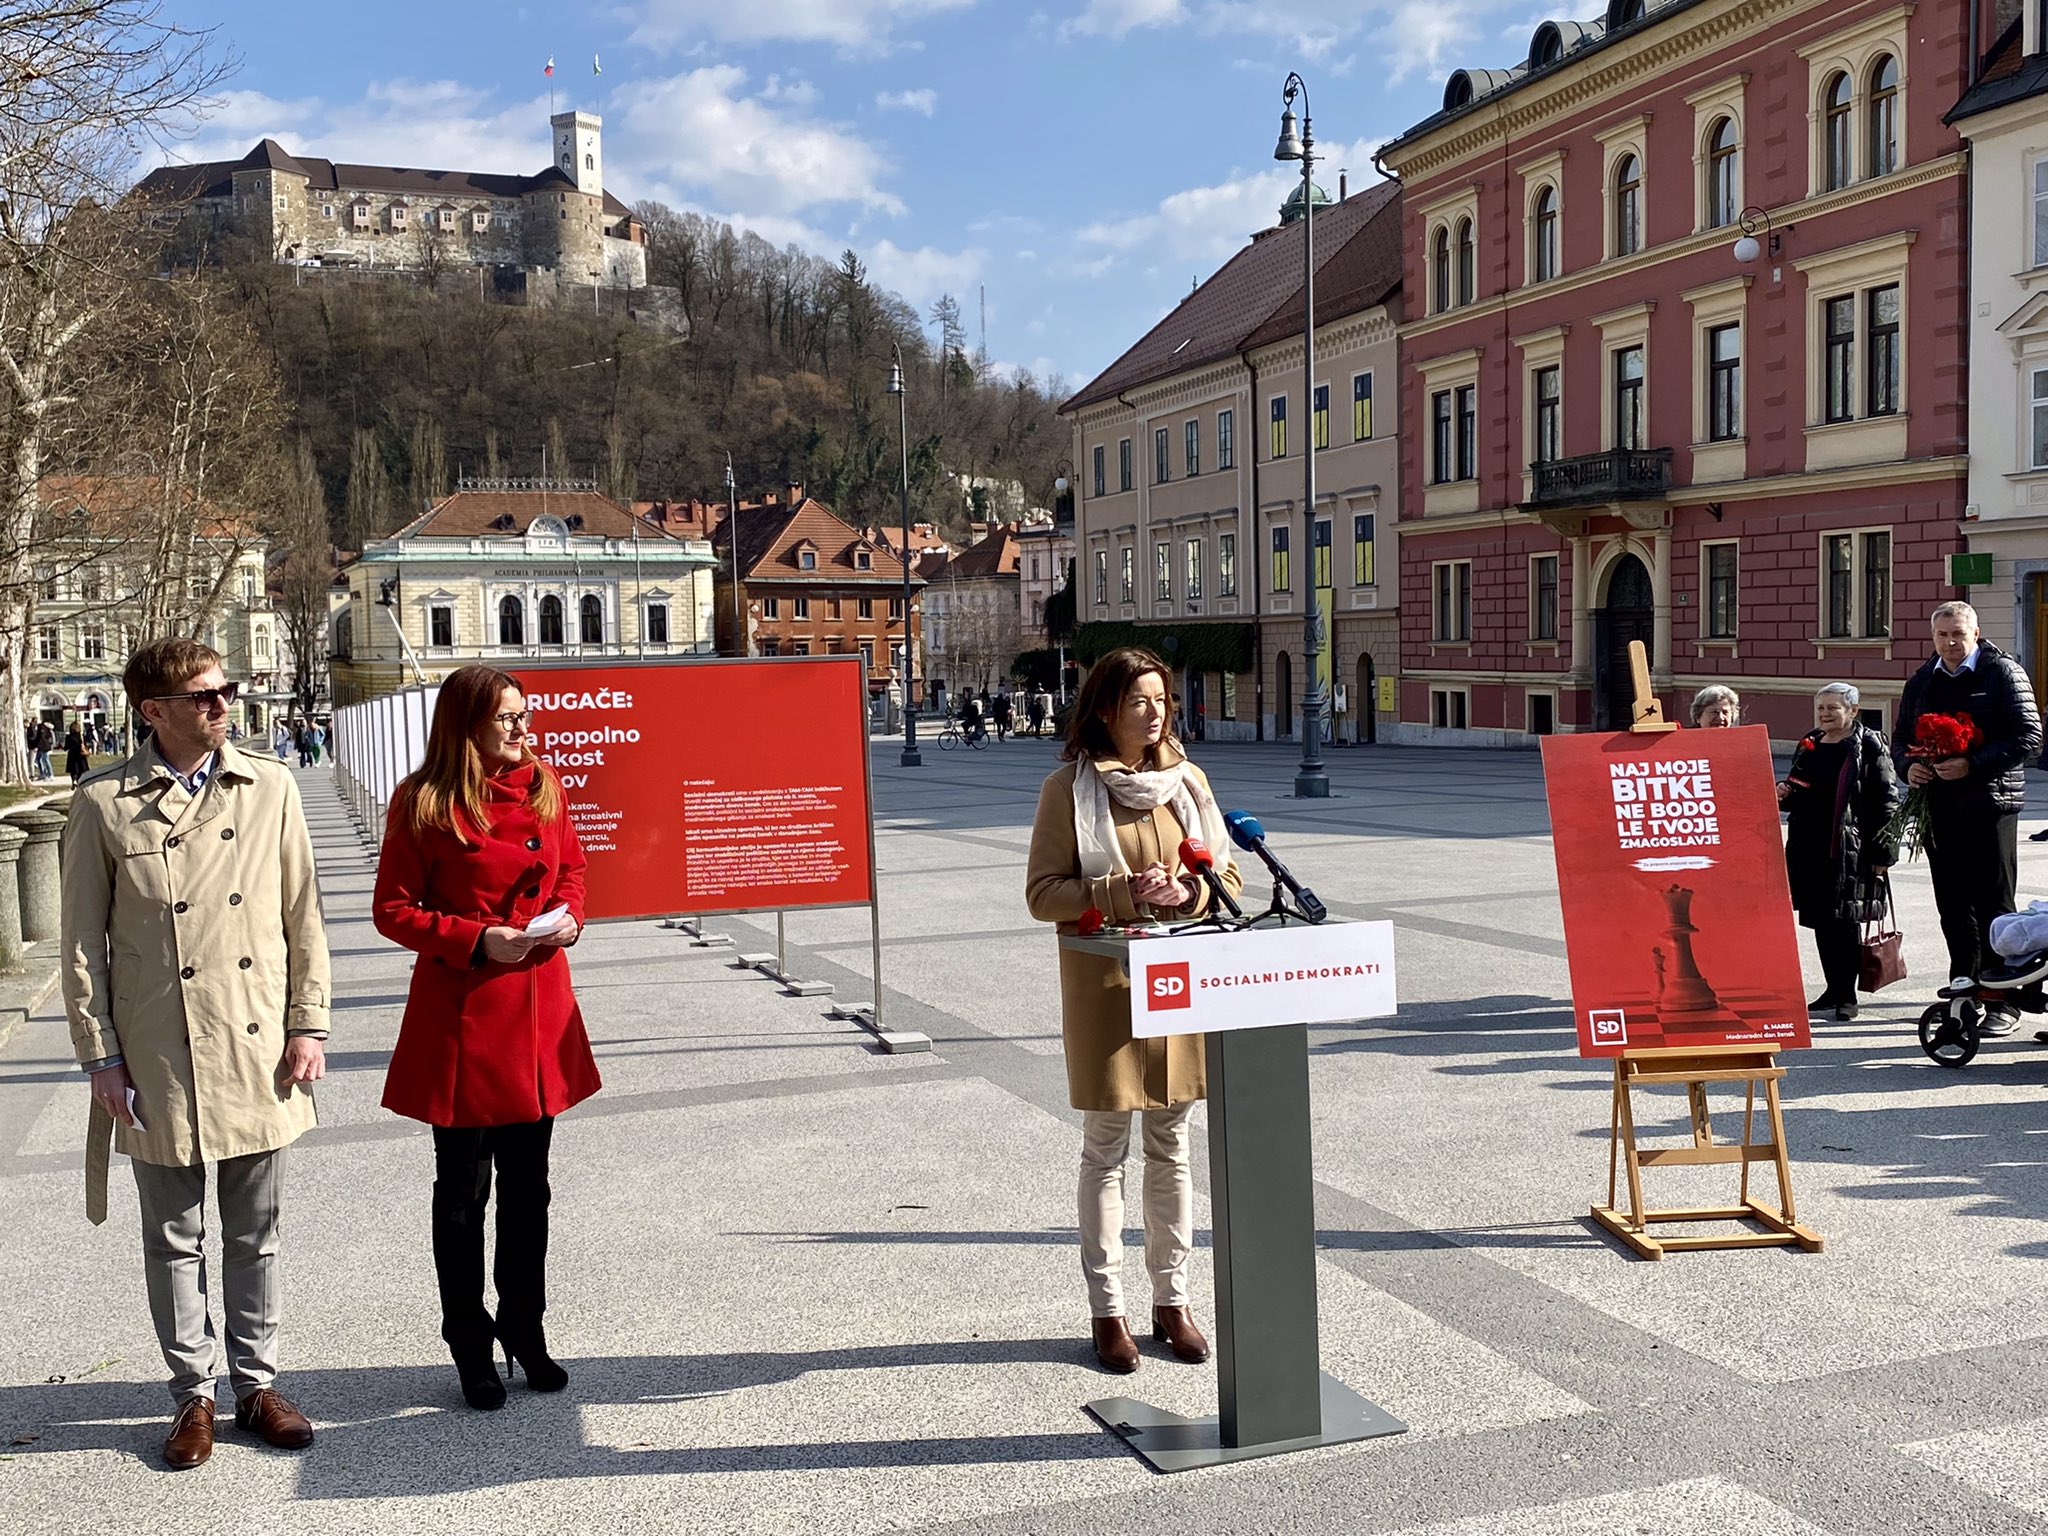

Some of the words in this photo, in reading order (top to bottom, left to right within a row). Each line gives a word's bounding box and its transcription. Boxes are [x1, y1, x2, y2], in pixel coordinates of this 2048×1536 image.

[544, 726, 640, 749] popolno
[541, 750, 604, 767] akost
[1610, 762, 1650, 778] NAJ
[1656, 759, 1710, 776] MOJE
[1611, 775, 1715, 802] BITKE
[581, 810, 622, 820] kreativni
[1615, 803, 1645, 819] NE
[1650, 800, 1716, 818] BODO
[576, 822, 618, 832] likovanje
[1617, 821, 1644, 837] LE
[1648, 817, 1719, 836] TVOJE
[586, 844, 616, 852] dnevu
[1620, 834, 1720, 849] ZMAGOSLAVJE
[1153, 976, 1184, 997] SD
[1200, 972, 1278, 988] SOCIALNI
[1285, 964, 1380, 982] DEMOKRATI
[1597, 1020, 1619, 1034] SD
